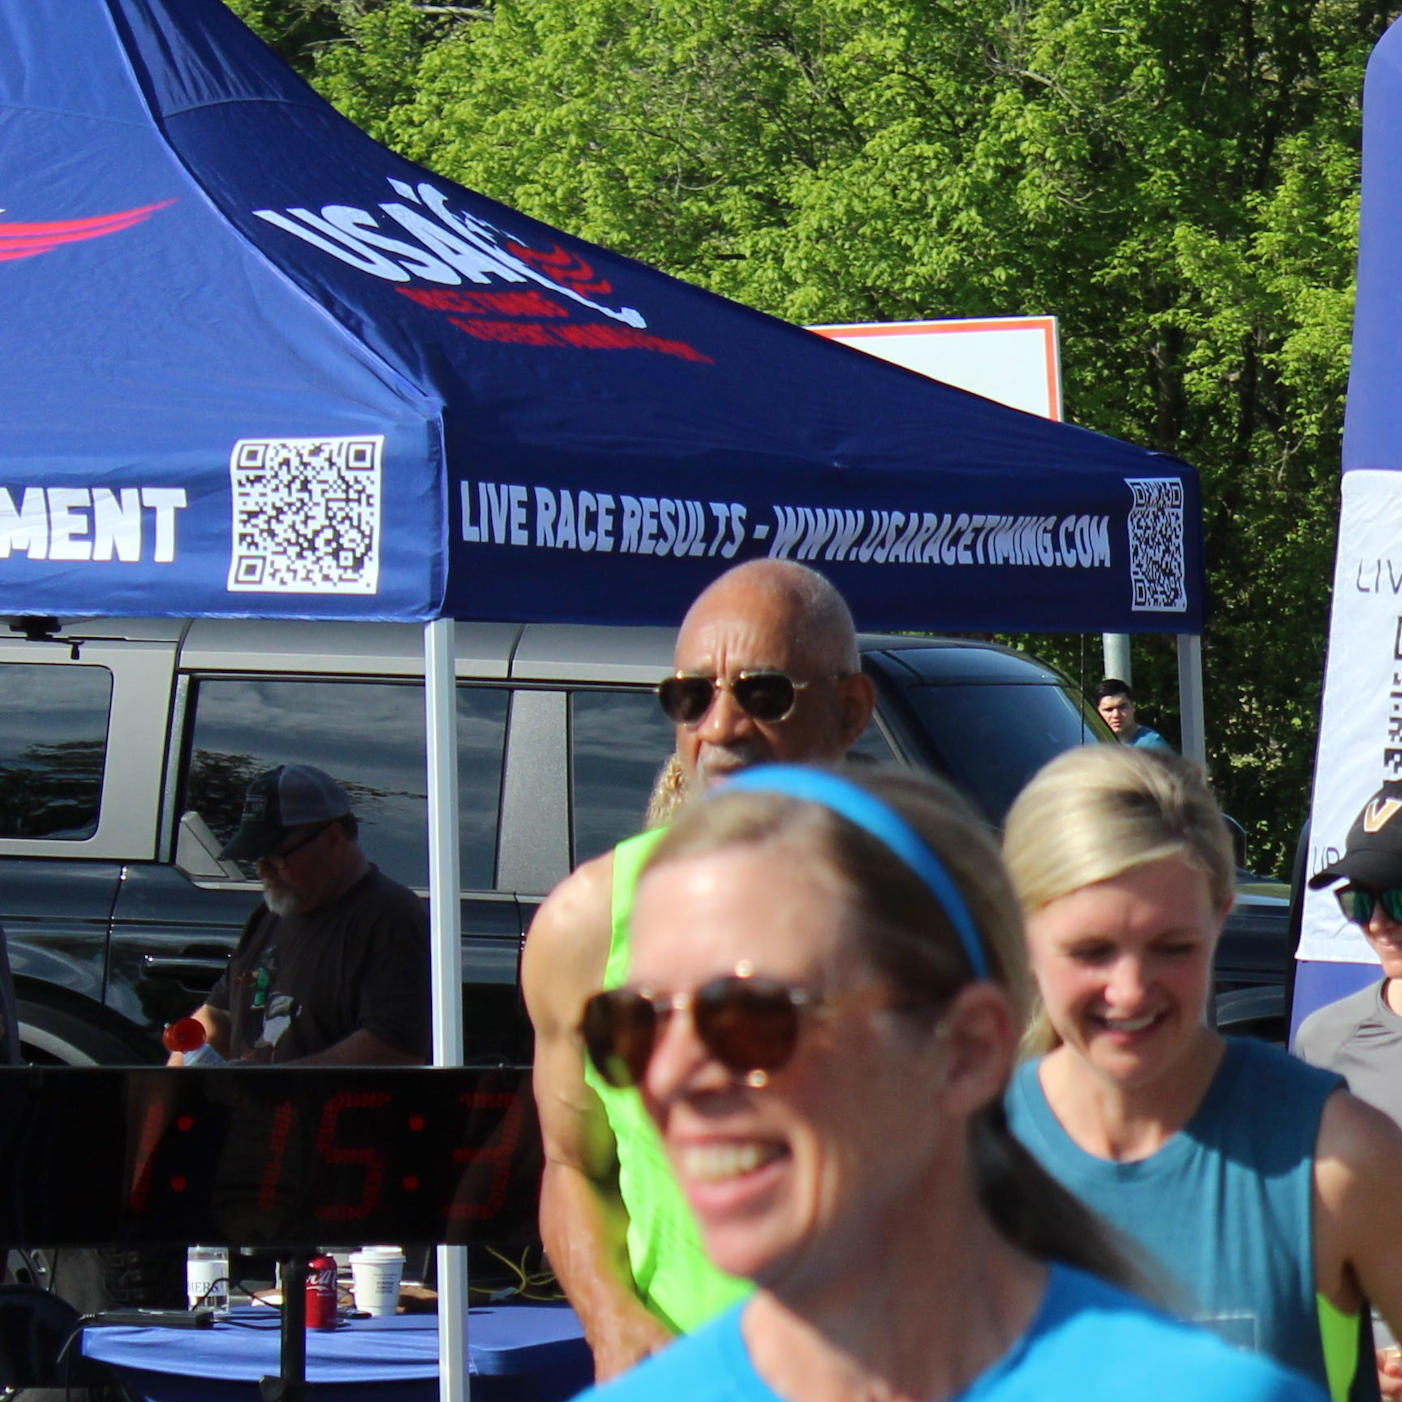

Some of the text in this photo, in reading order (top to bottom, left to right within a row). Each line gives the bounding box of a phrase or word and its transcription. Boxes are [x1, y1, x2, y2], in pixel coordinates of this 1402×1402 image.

[461, 480, 528, 547] LIVE
[535, 488, 614, 551] RACE
[620, 495, 747, 559] RESULTS
[773, 504, 1111, 569] WWW.USARACETIMING.COM
